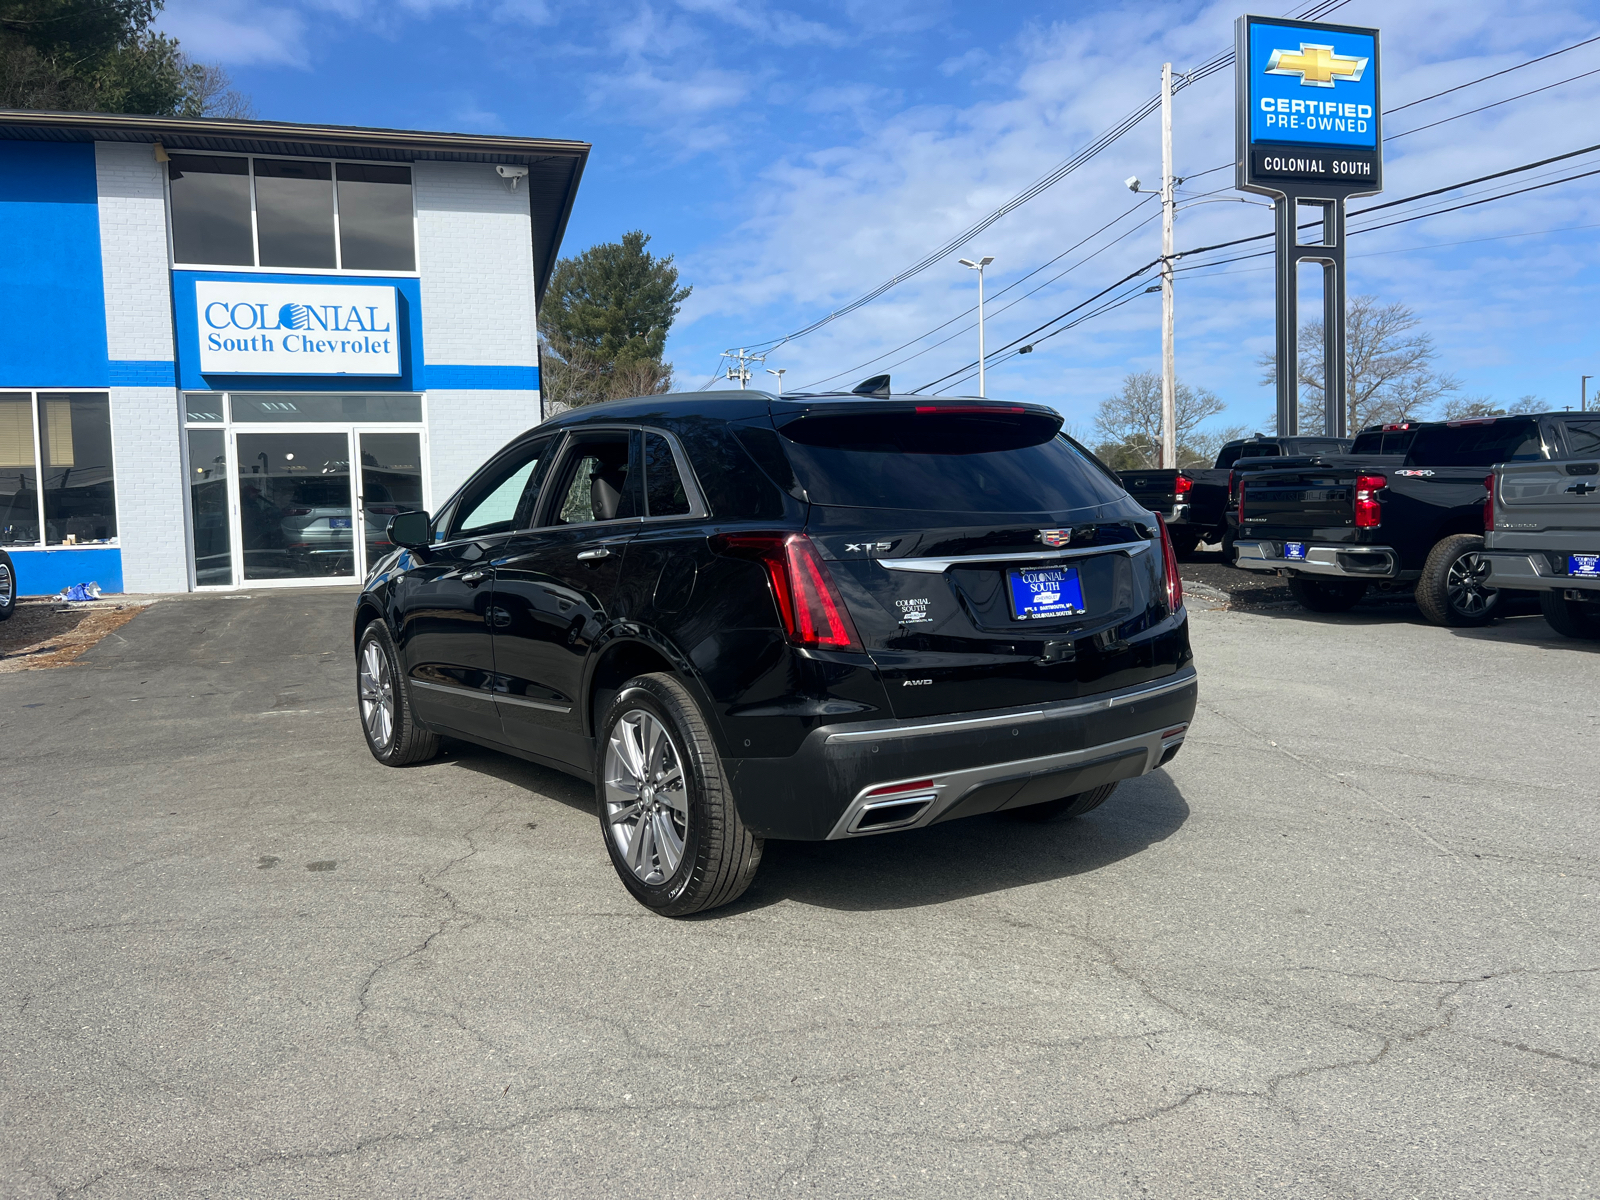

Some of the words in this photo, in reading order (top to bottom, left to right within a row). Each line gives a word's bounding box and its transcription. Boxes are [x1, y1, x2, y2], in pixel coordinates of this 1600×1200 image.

[1260, 97, 1372, 119] CERTIFIED
[1266, 114, 1368, 133] PRE-OWNED
[1264, 156, 1326, 173] COLONIAL
[1332, 161, 1371, 175] SOUTH
[204, 301, 390, 332] COLONIAL
[207, 332, 275, 352] South
[282, 333, 391, 354] Chevrolet
[844, 541, 892, 552] XT5
[1022, 572, 1065, 584] COLONIAL
[1030, 582, 1060, 593] SOUTH
[895, 598, 931, 607] COLONIAL
[901, 604, 926, 613] SOUTH
[902, 679, 933, 687] AWD
